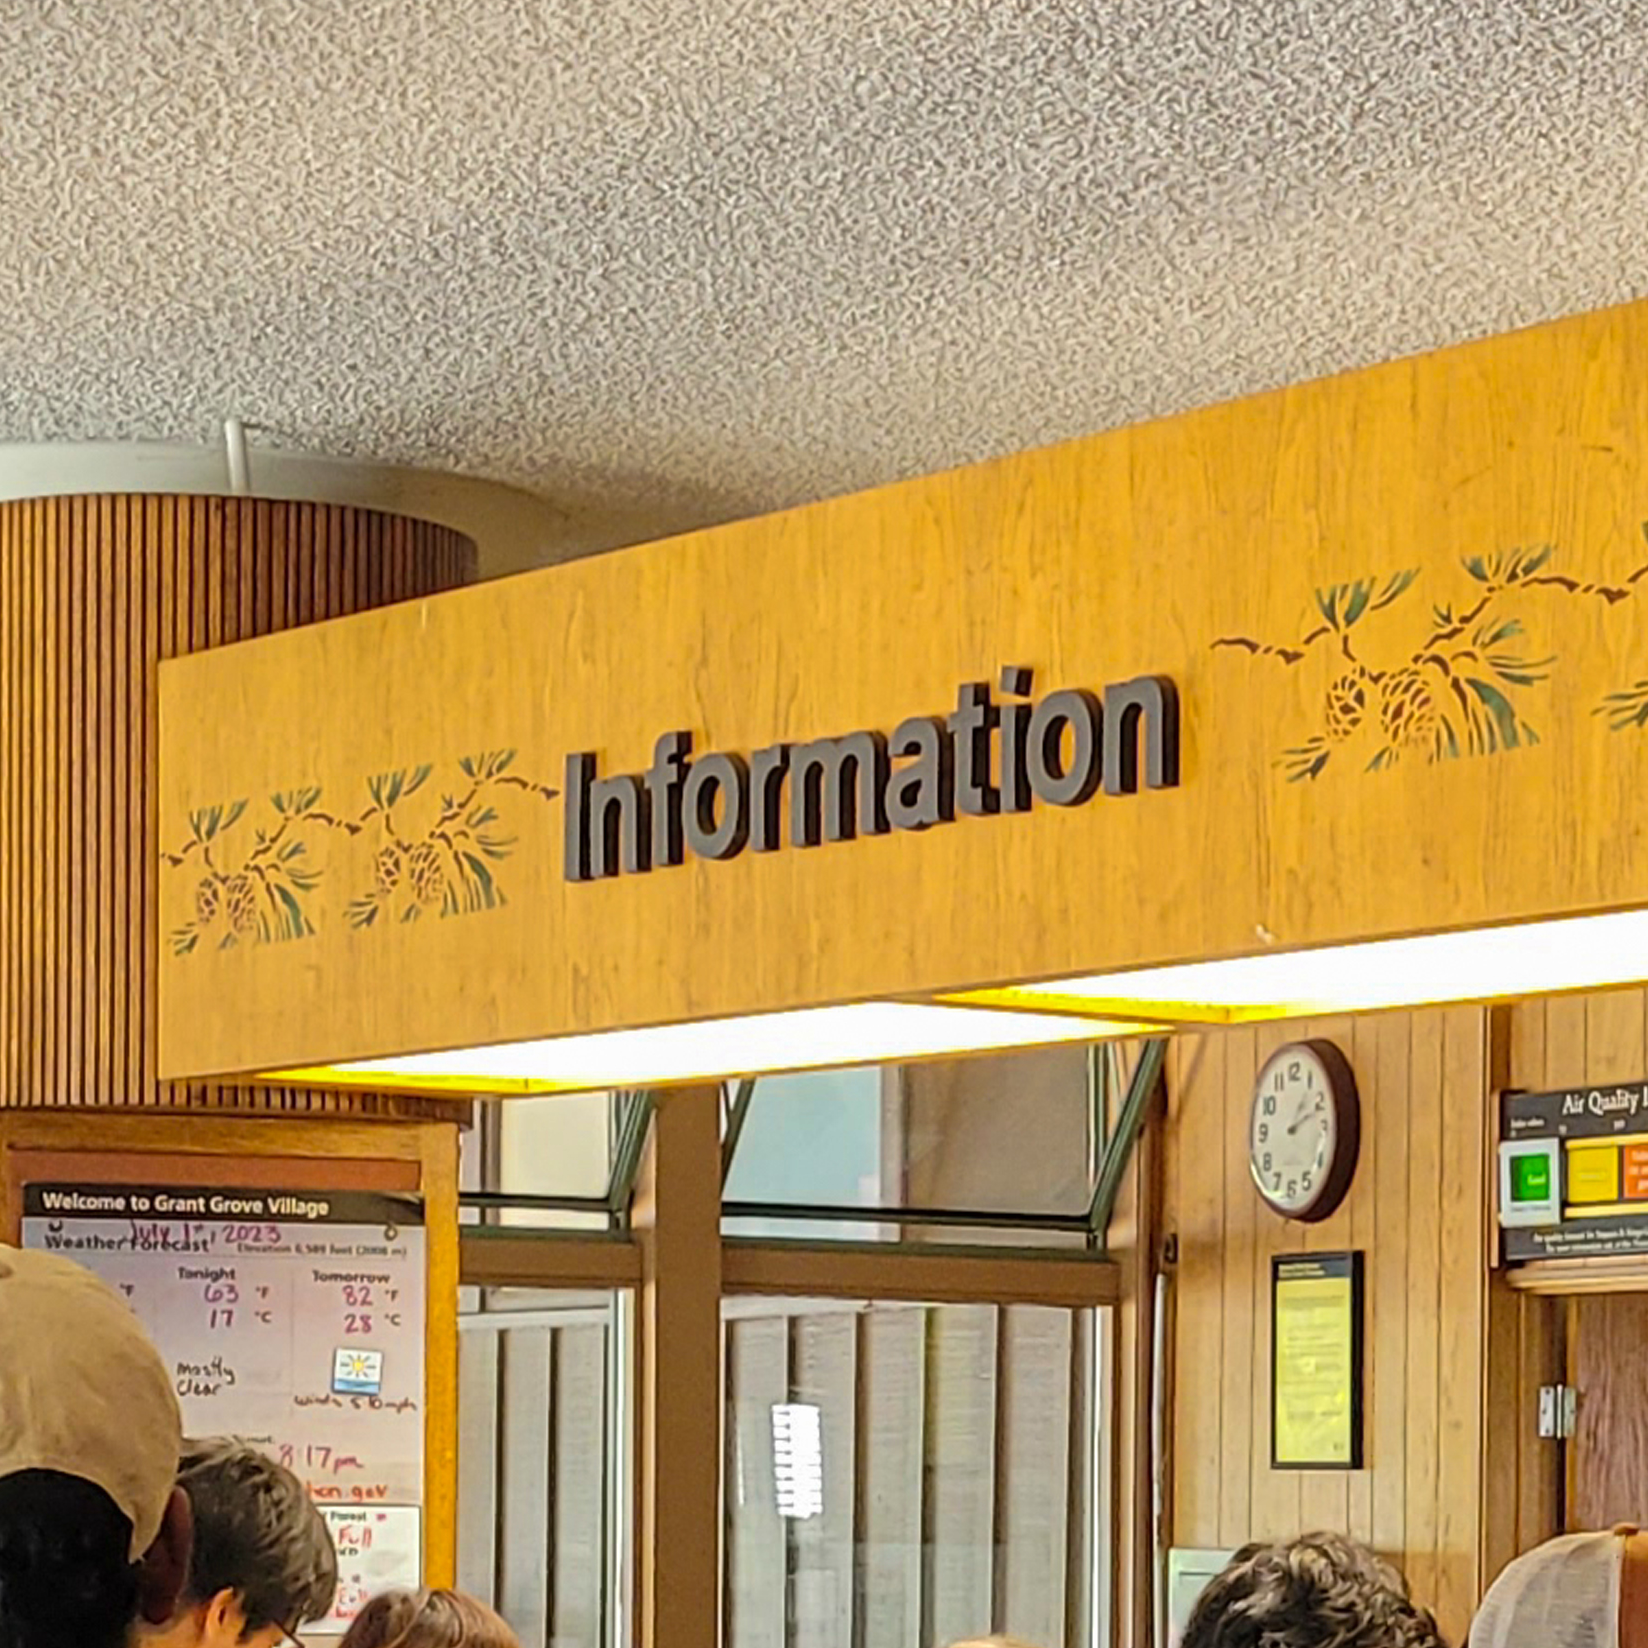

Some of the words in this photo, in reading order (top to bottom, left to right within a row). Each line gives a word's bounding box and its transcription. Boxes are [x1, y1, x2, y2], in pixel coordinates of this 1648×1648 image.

[563, 664, 1181, 882] Information
[1274, 1071, 1285, 1092] 11
[1287, 1062, 1301, 1082] 12
[1262, 1095, 1276, 1116] 10
[1562, 1094, 1585, 1115] Air
[1588, 1089, 1639, 1116] Quality
[1258, 1123, 1269, 1143] 9
[1263, 1152, 1272, 1172] 8
[1273, 1171, 1282, 1192] 7
[1302, 1170, 1312, 1191] 5
[42, 1191, 126, 1212] Welcome
[130, 1195, 151, 1212] to
[154, 1194, 206, 1213] Grant
[209, 1196, 264, 1215] Grove
[267, 1197, 330, 1219] Village
[44, 1233, 123, 1251] Weather
[222, 1223, 282, 1244] 2023
[178, 1266, 237, 1283] Tonight
[312, 1269, 391, 1284] Tomorrow
[204, 1283, 240, 1304] 63
[342, 1284, 374, 1307] 82
[210, 1308, 235, 1329] 17
[343, 1313, 372, 1334] 28
